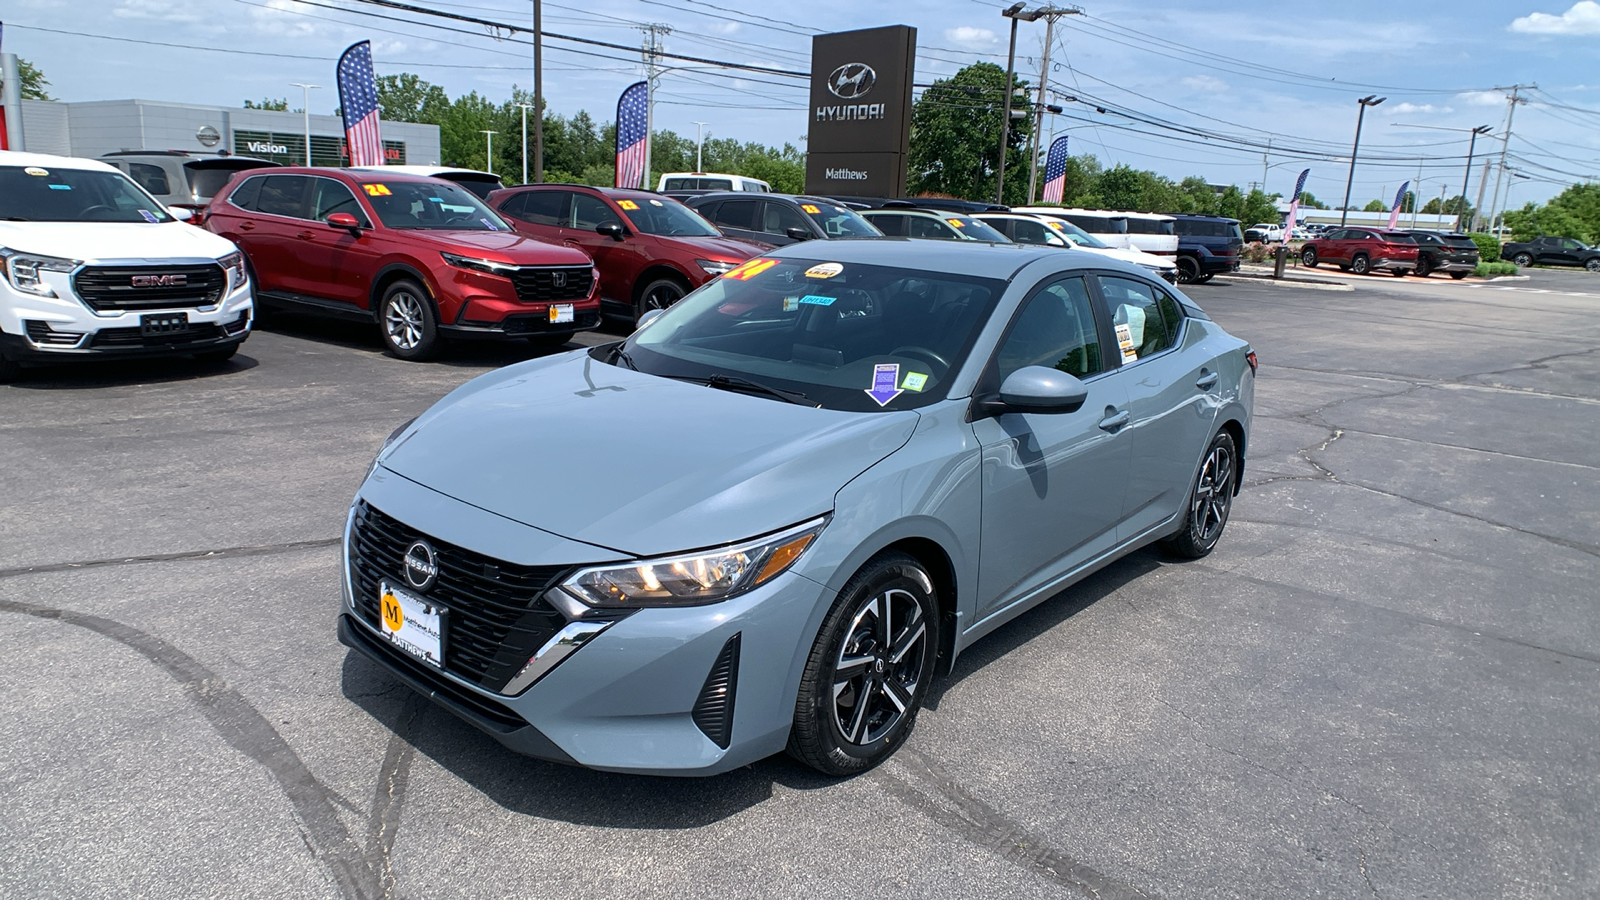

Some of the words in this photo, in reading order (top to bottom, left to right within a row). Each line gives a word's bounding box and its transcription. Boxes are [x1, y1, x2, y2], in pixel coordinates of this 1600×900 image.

[816, 103, 885, 121] HYUNDAI
[247, 141, 287, 154] Vision
[825, 168, 868, 180] Matthews
[363, 184, 392, 197] 24
[723, 259, 776, 280] 24
[132, 274, 187, 286] GMC
[404, 555, 435, 575] NISSAN
[384, 600, 400, 625] M
[403, 614, 428, 633] Matthews
[392, 634, 427, 660] MATTHEWS
